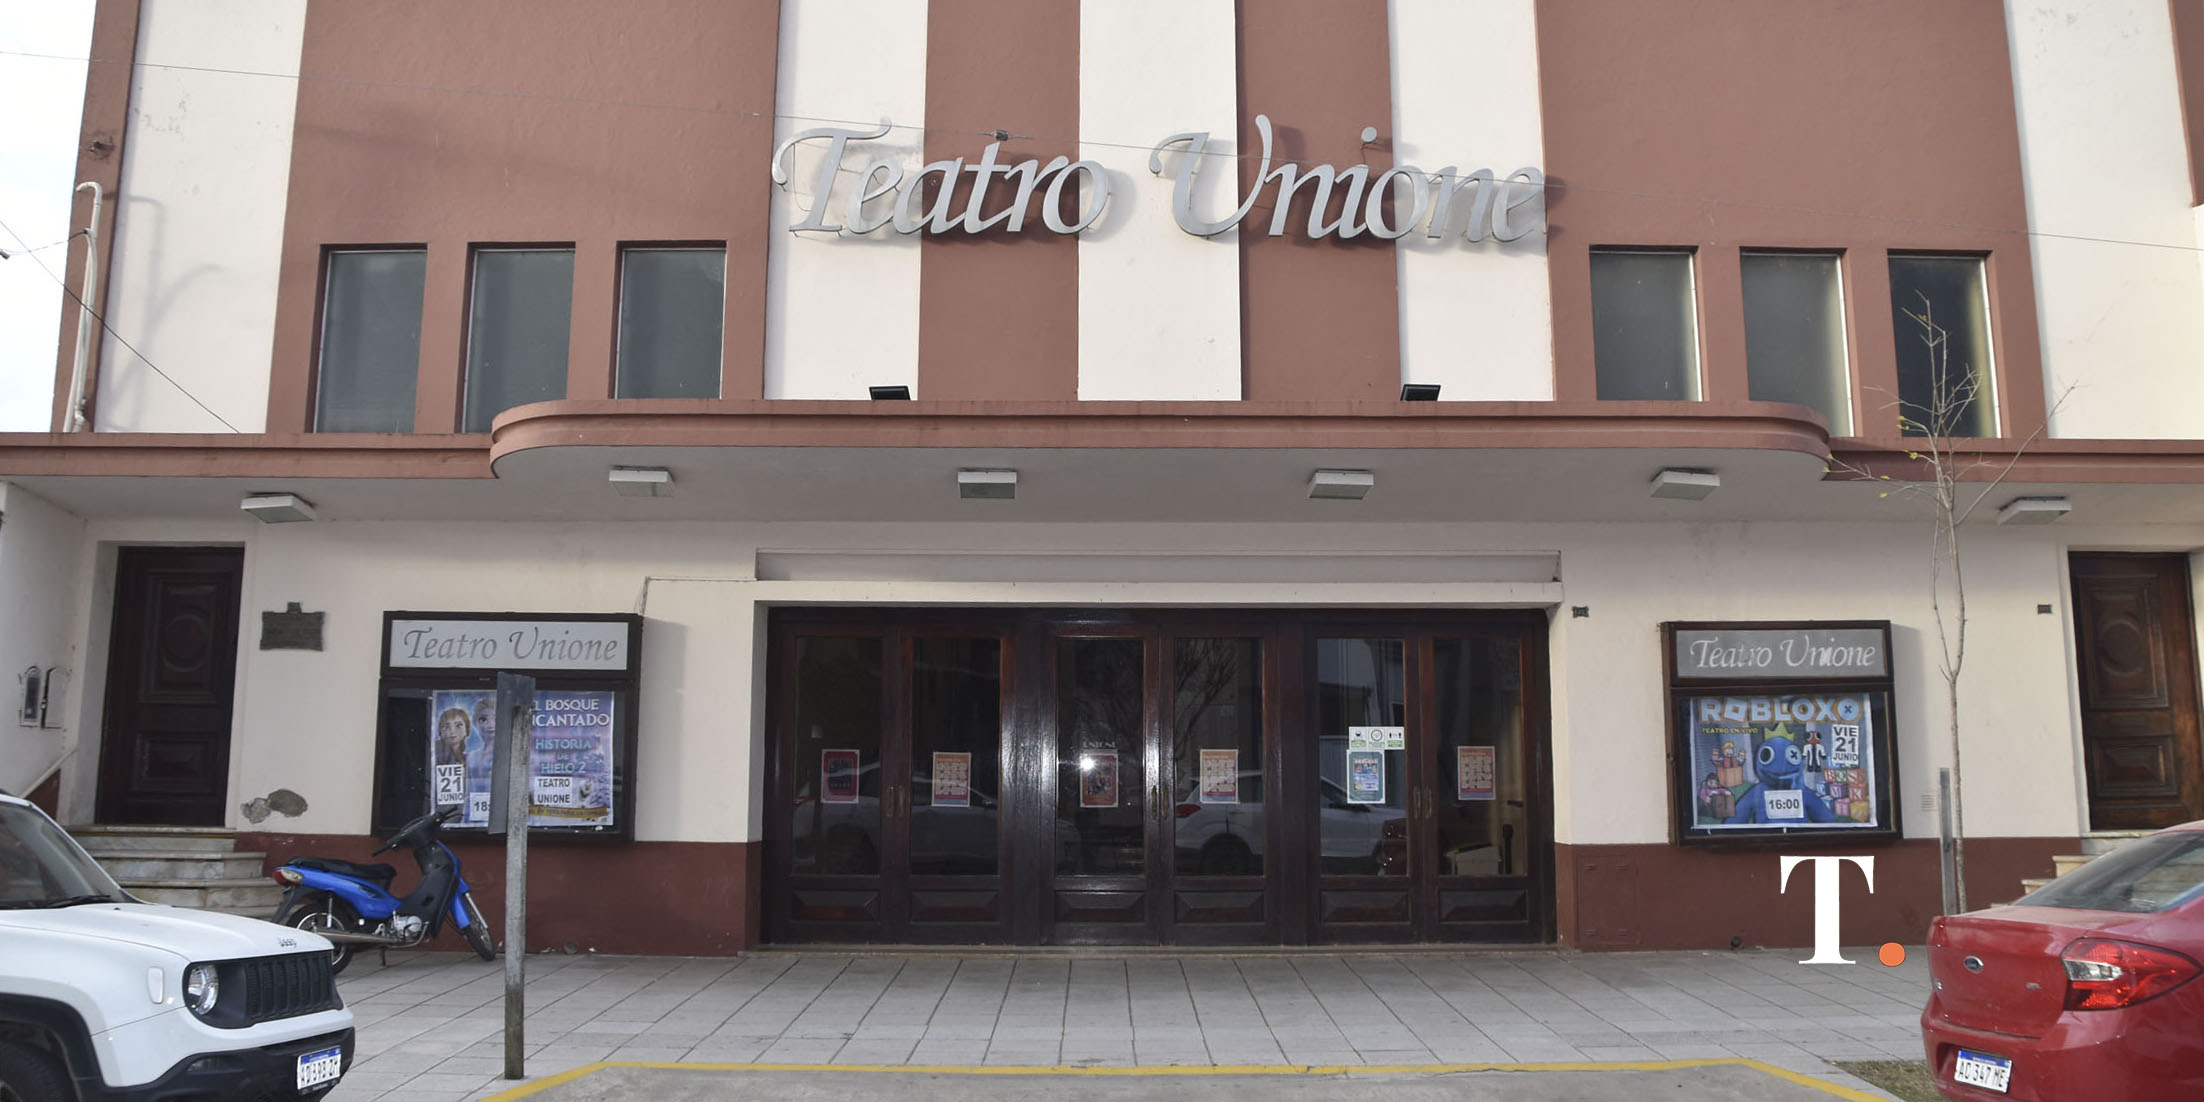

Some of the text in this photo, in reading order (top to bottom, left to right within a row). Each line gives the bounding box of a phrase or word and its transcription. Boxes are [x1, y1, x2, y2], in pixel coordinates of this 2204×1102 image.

[771, 114, 1544, 243] Teatro Unione
[404, 626, 618, 661] Teatro Unione
[1690, 635, 1876, 668] Teatro Unione
[545, 699, 600, 712] BOSQUE
[532, 713, 610, 727] CANTADO
[1833, 726, 1858, 737] VIE
[535, 738, 592, 750] HISTORIA
[1835, 737, 1857, 753] 21
[1833, 752, 1859, 762] JUNIO
[437, 766, 463, 777] VIE
[540, 761, 587, 774] HIELO 2
[440, 777, 461, 793] 21
[537, 778, 571, 788] TEATRO
[438, 793, 465, 802] JUNIO
[537, 794, 571, 804] UNIONE
[1769, 798, 1800, 810] 16:00
